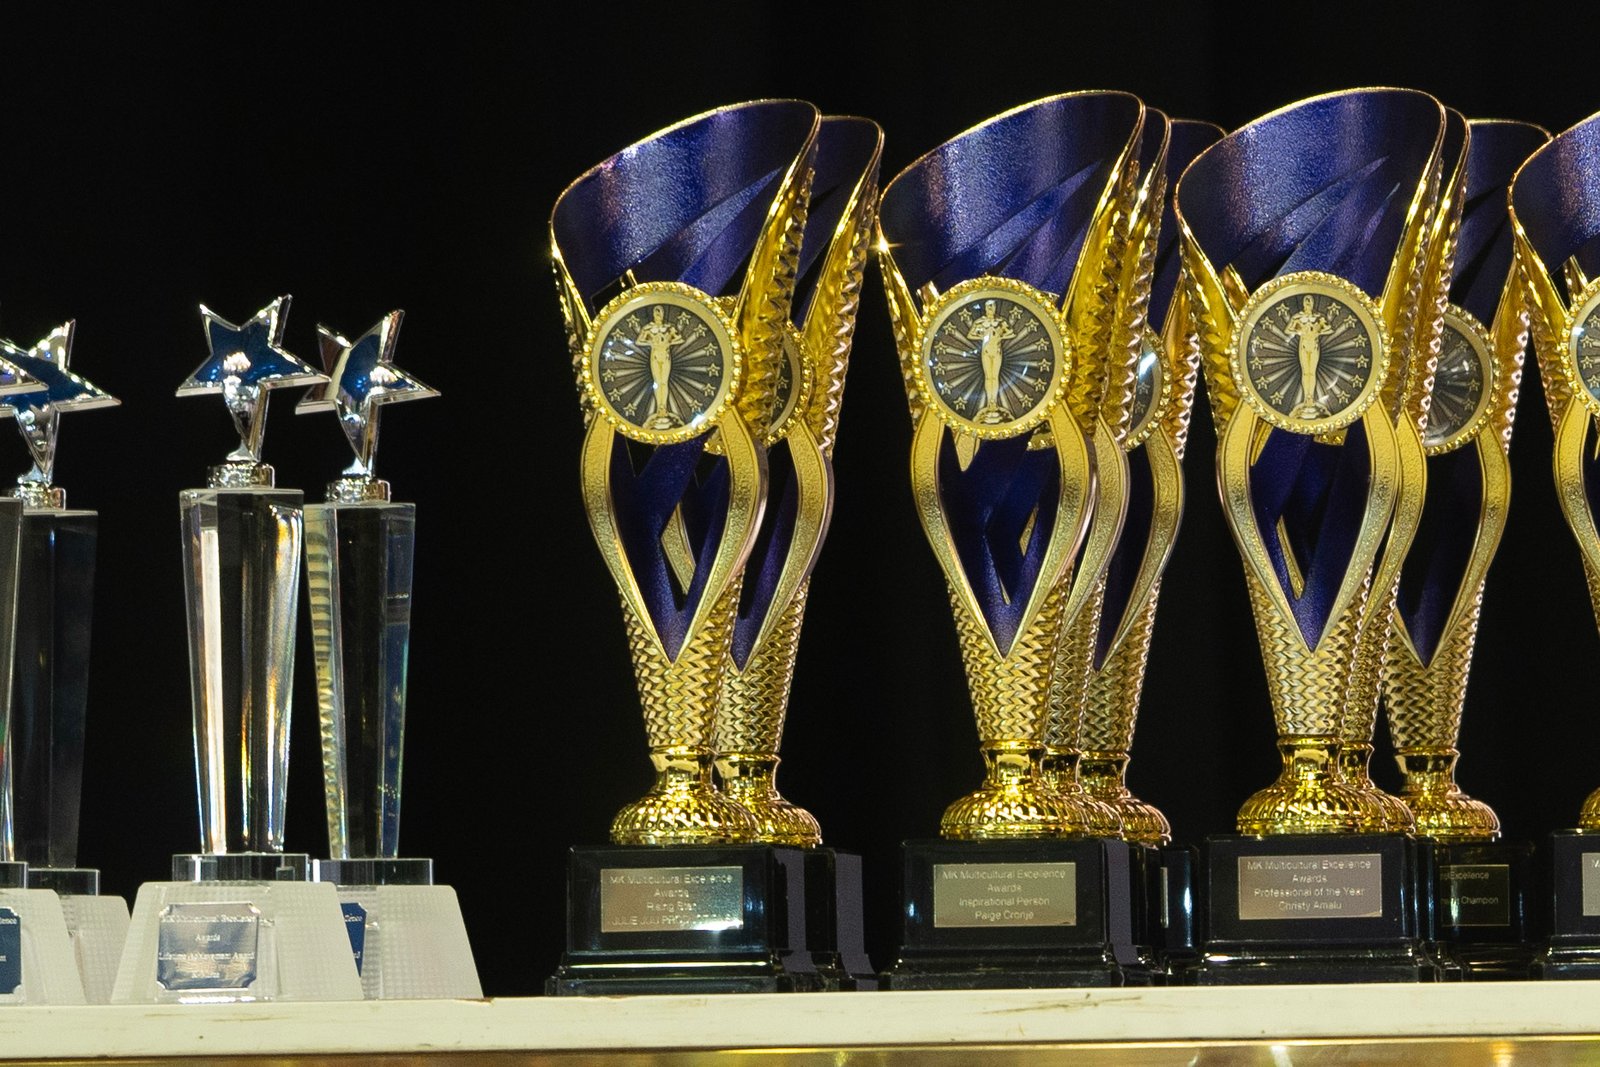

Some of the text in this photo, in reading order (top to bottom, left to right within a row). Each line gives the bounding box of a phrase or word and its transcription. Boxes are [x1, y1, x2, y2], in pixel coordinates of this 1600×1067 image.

[1265, 860, 1319, 870] Multicultural
[1322, 859, 1371, 870] Excellence
[943, 869, 1065, 879] MK Multicultural Excellence
[1292, 874, 1327, 883] Awards
[1450, 871, 1489, 880] Excellence
[654, 889, 689, 898] Awards
[987, 884, 1021, 893] Awards
[1254, 887, 1365, 897] Professional of the Year
[959, 896, 1050, 908] Inspirational Person
[1279, 901, 1310, 911] Christy
[975, 910, 1001, 921] Paige
